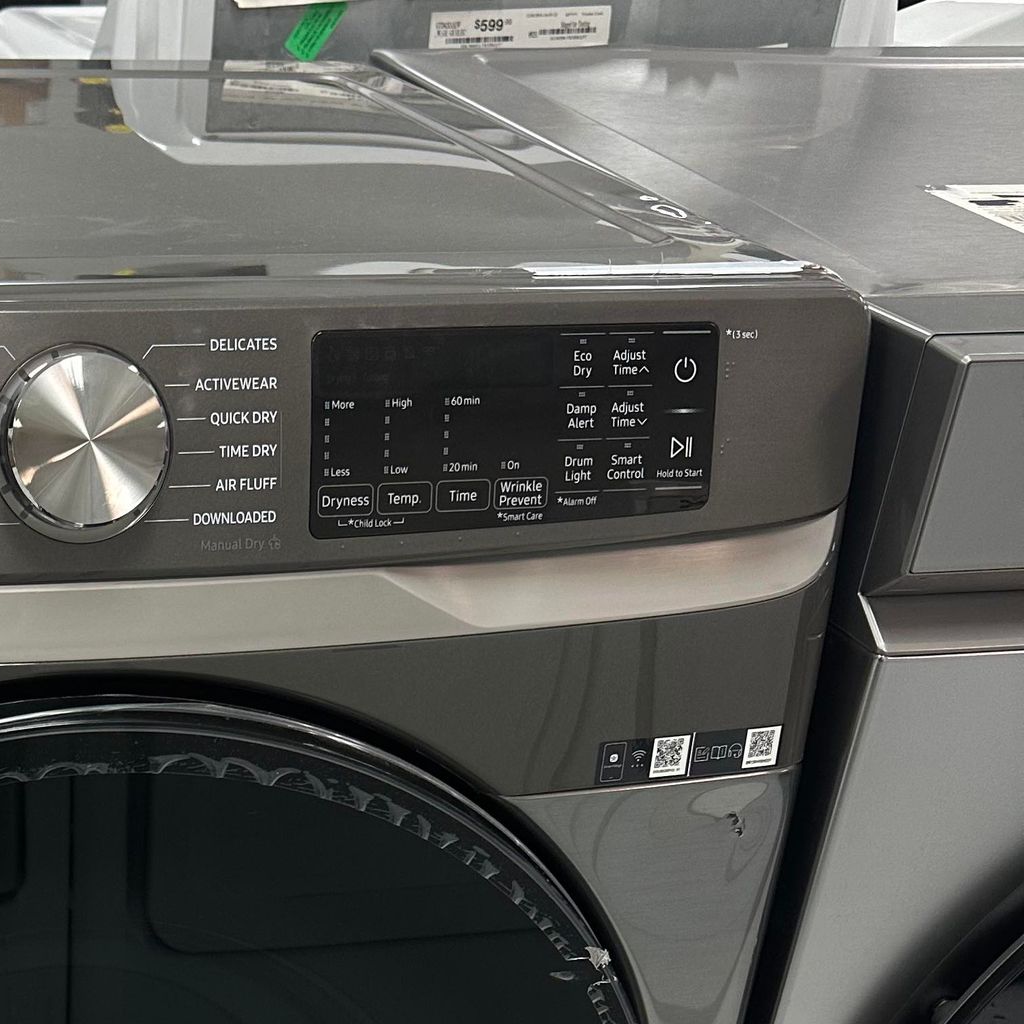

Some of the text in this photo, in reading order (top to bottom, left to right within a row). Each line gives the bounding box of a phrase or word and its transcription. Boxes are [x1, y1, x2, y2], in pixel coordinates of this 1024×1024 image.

[475, 18, 504, 33] $599
[210, 338, 278, 352] DELICATES
[573, 350, 593, 362] Eco
[613, 350, 647, 366] Adjust
[573, 365, 592, 379] Dry
[613, 364, 638, 376] Time
[195, 377, 278, 391] ACTIVEWEAR
[331, 400, 355, 410] More
[391, 398, 413, 410] High
[566, 403, 597, 416] Damp
[611, 402, 645, 417] Adjust
[210, 410, 278, 427] QUICK DRY
[567, 418, 595, 429] Alert
[611, 416, 636, 428] Time
[219, 444, 278, 458] TIME DRY
[507, 460, 520, 470] On
[564, 456, 594, 467] Drum
[611, 454, 643, 466] Smart
[330, 467, 351, 478] Less
[390, 465, 409, 475] Low
[606, 468, 644, 480] Control
[656, 468, 703, 478] Hold to Start
[215, 477, 278, 491] AIR FLUFF
[565, 471, 592, 484] Light
[500, 480, 543, 494] Wrinkle
[321, 494, 370, 509] Dryness
[387, 491, 422, 506] Temp.
[449, 489, 478, 502] Time
[498, 494, 543, 507] Prevent
[585, 496, 597, 505] Off
[193, 510, 277, 526] DOWNLOADED
[374, 517, 392, 527] Lock
[526, 511, 544, 521] Care
[201, 538, 265, 552] Manual Dry
